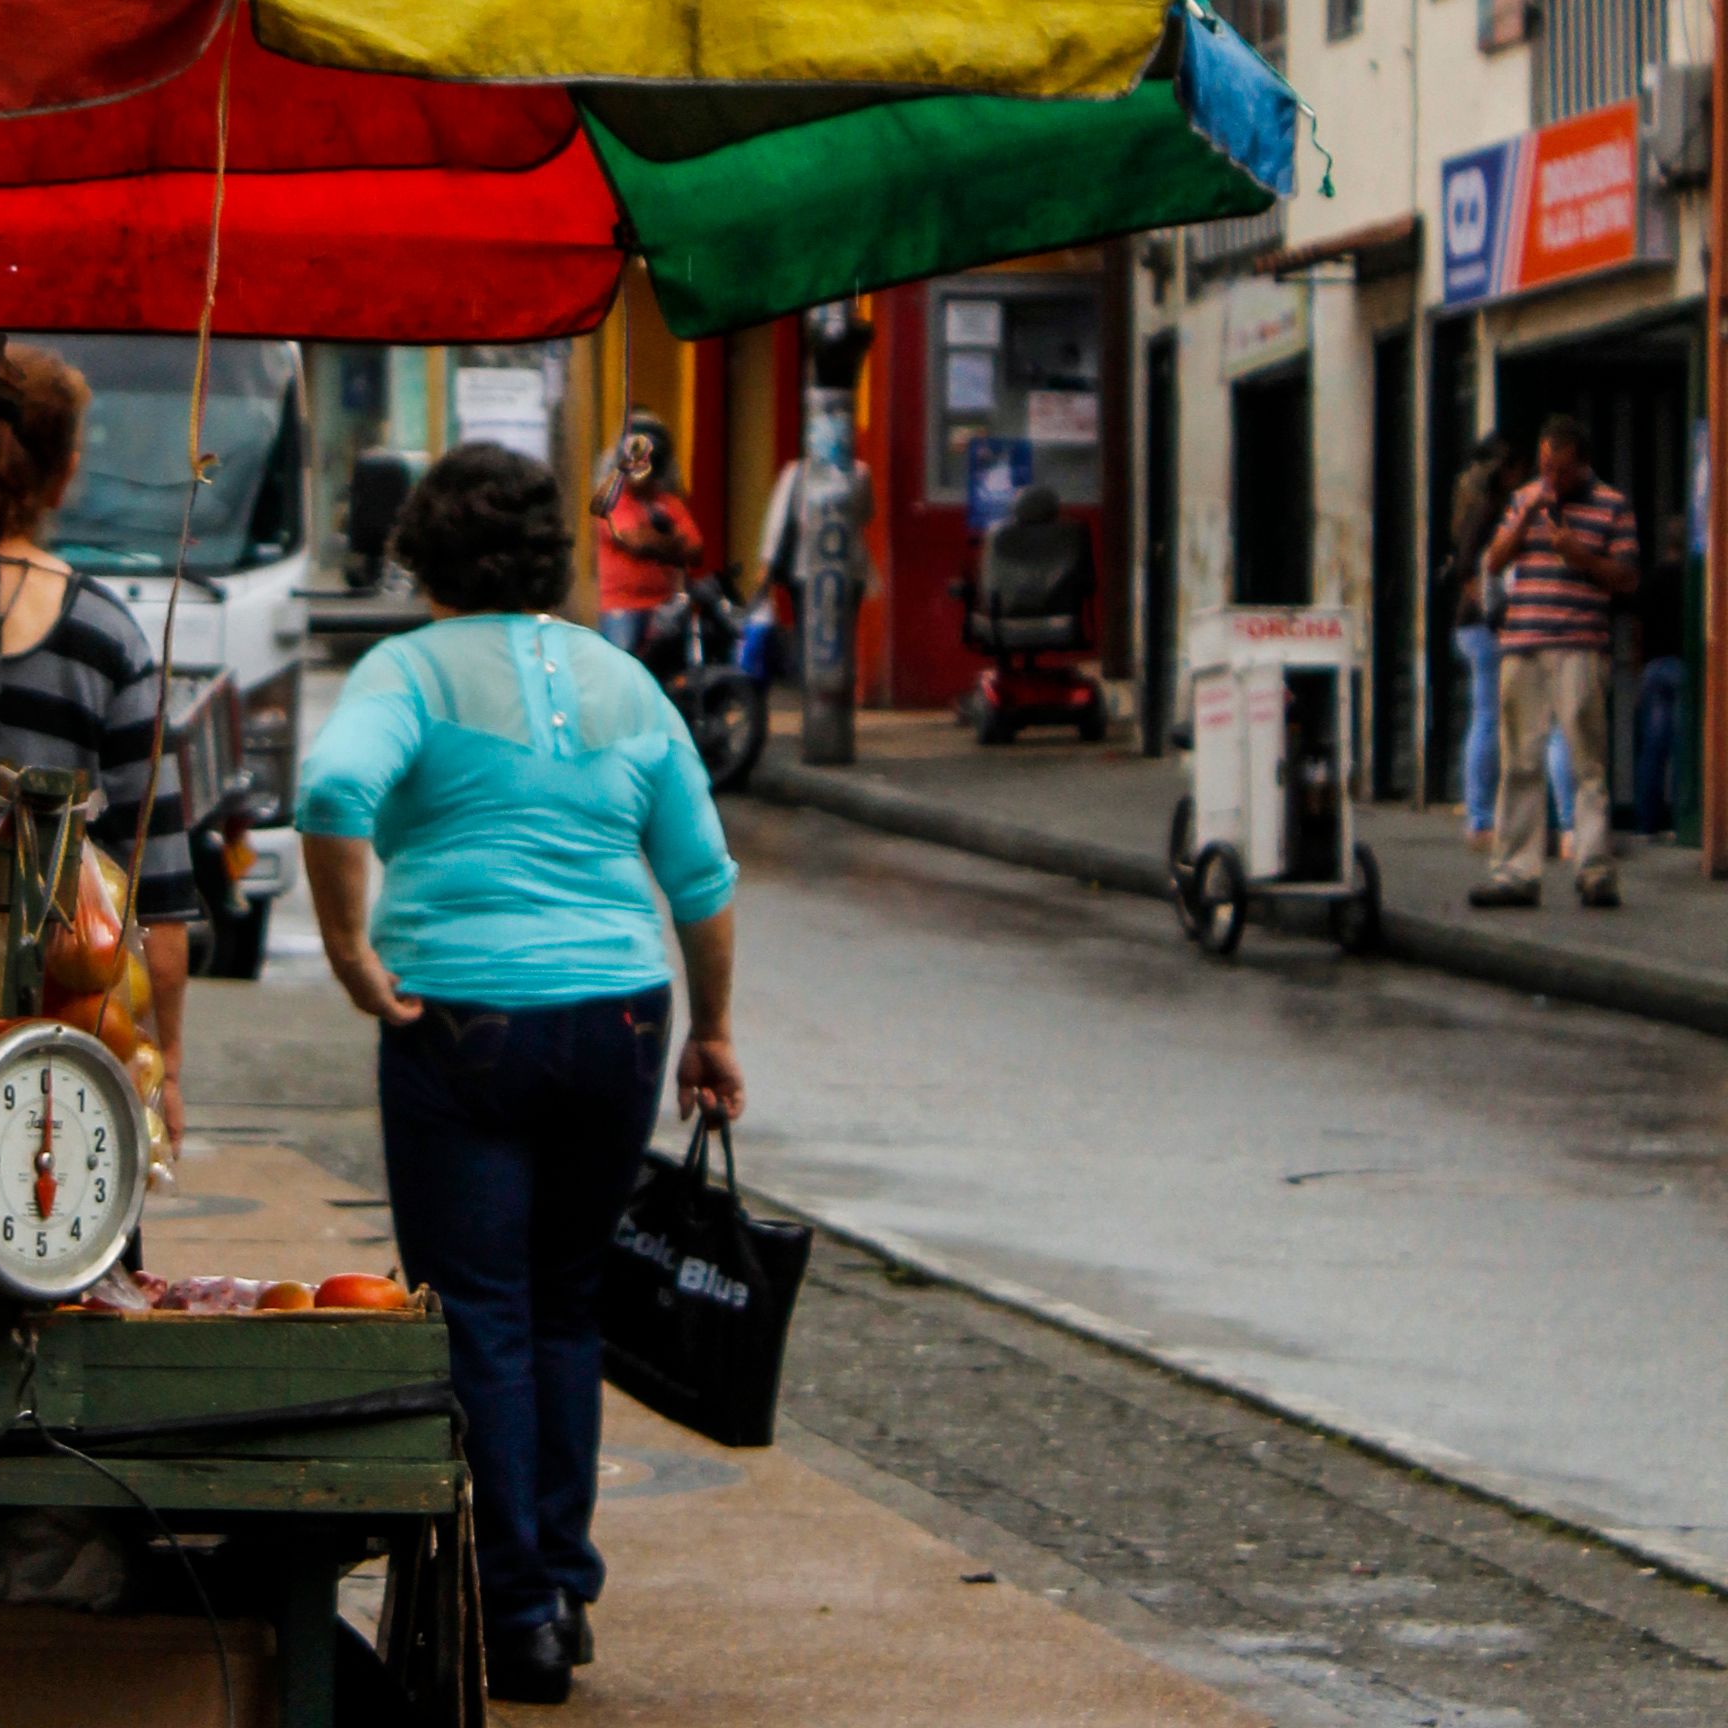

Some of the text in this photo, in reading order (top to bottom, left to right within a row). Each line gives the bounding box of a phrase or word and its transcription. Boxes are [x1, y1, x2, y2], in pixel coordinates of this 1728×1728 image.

[40, 1068, 52, 1095] 0
[4, 1084, 16, 1110] 9
[76, 1087, 86, 1113] 1
[93, 1127, 107, 1153] 2
[94, 1178, 107, 1203] 3
[3, 1215, 15, 1241] 6
[70, 1217, 82, 1241] 4
[36, 1232, 48, 1258] 5
[679, 1256, 750, 1307] Blue
